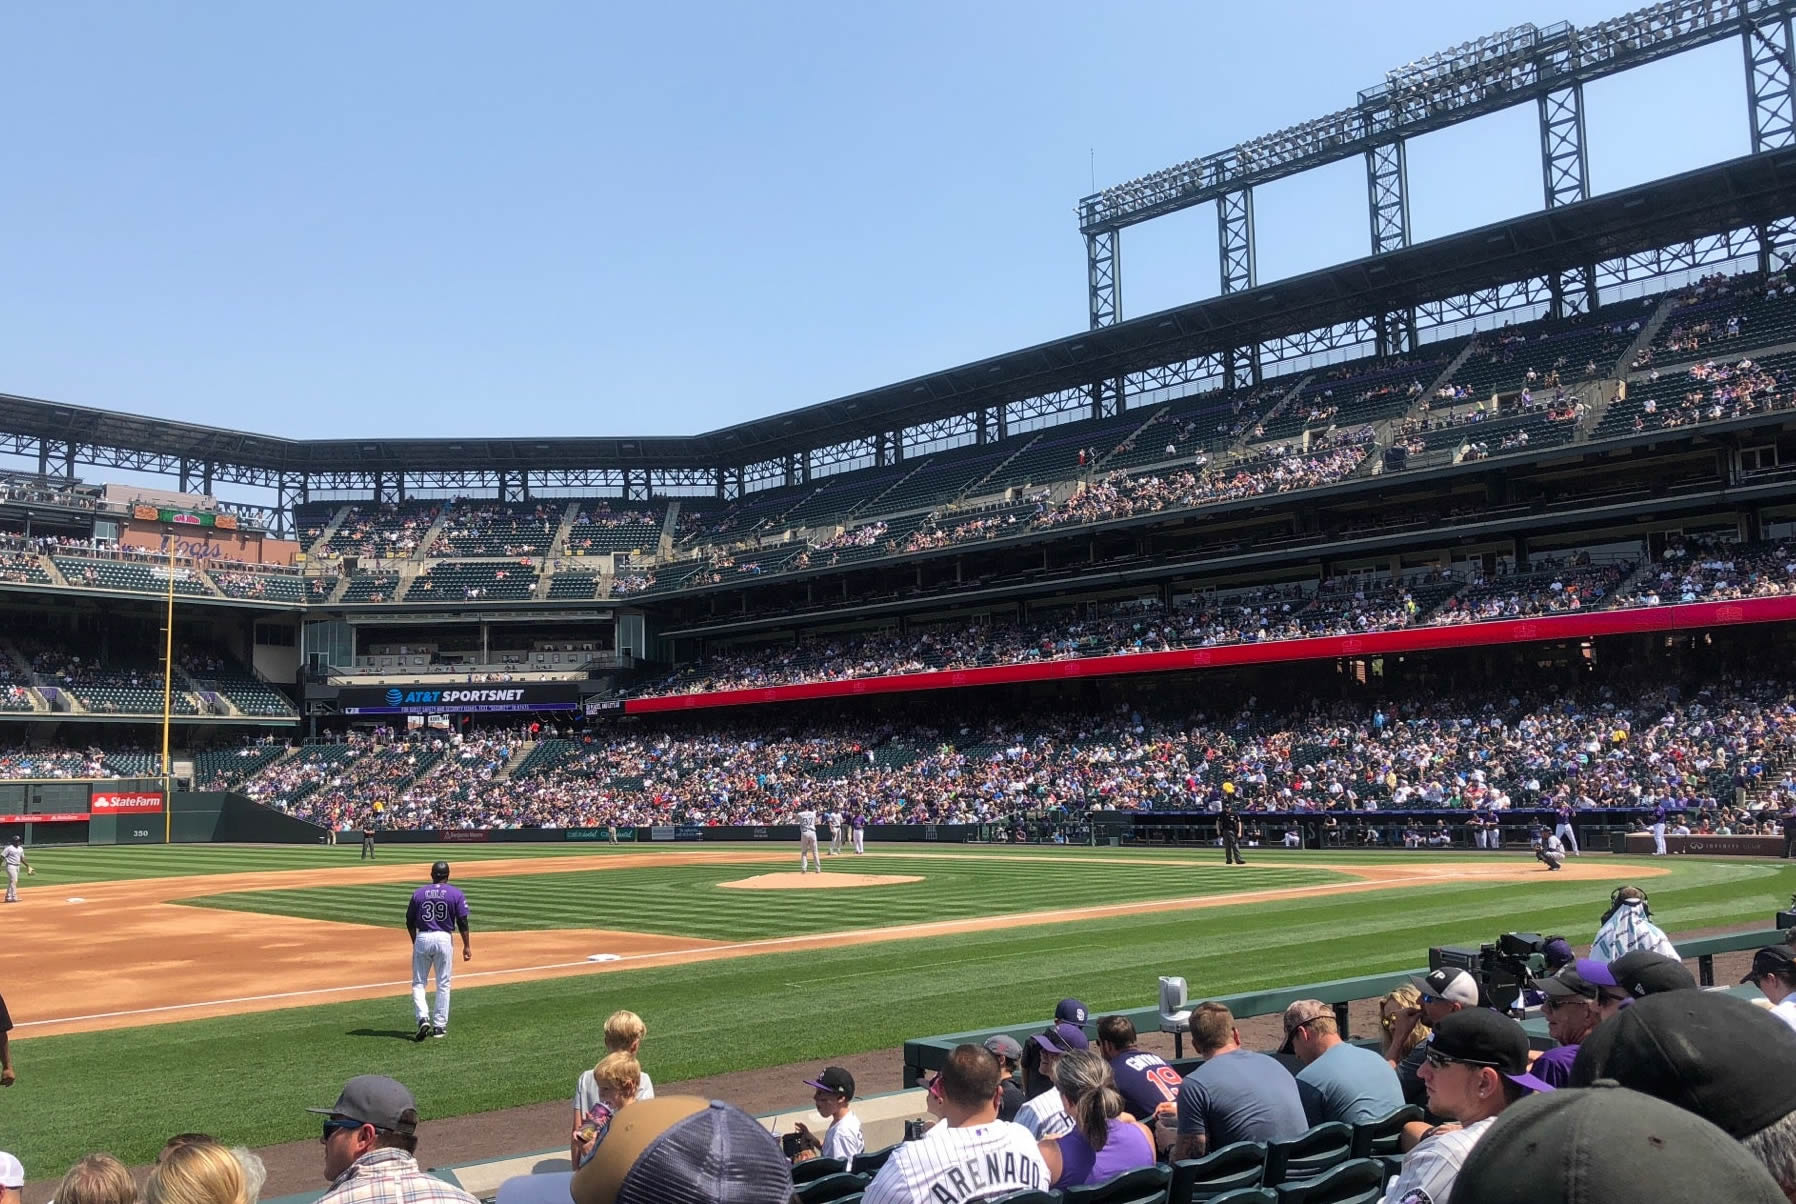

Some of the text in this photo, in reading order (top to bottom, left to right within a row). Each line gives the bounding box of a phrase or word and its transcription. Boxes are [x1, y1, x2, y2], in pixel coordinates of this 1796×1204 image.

[405, 689, 524, 702] AT&T SPORTSNET
[421, 900, 448, 922] 39
[1146, 1066, 1183, 1102] 19
